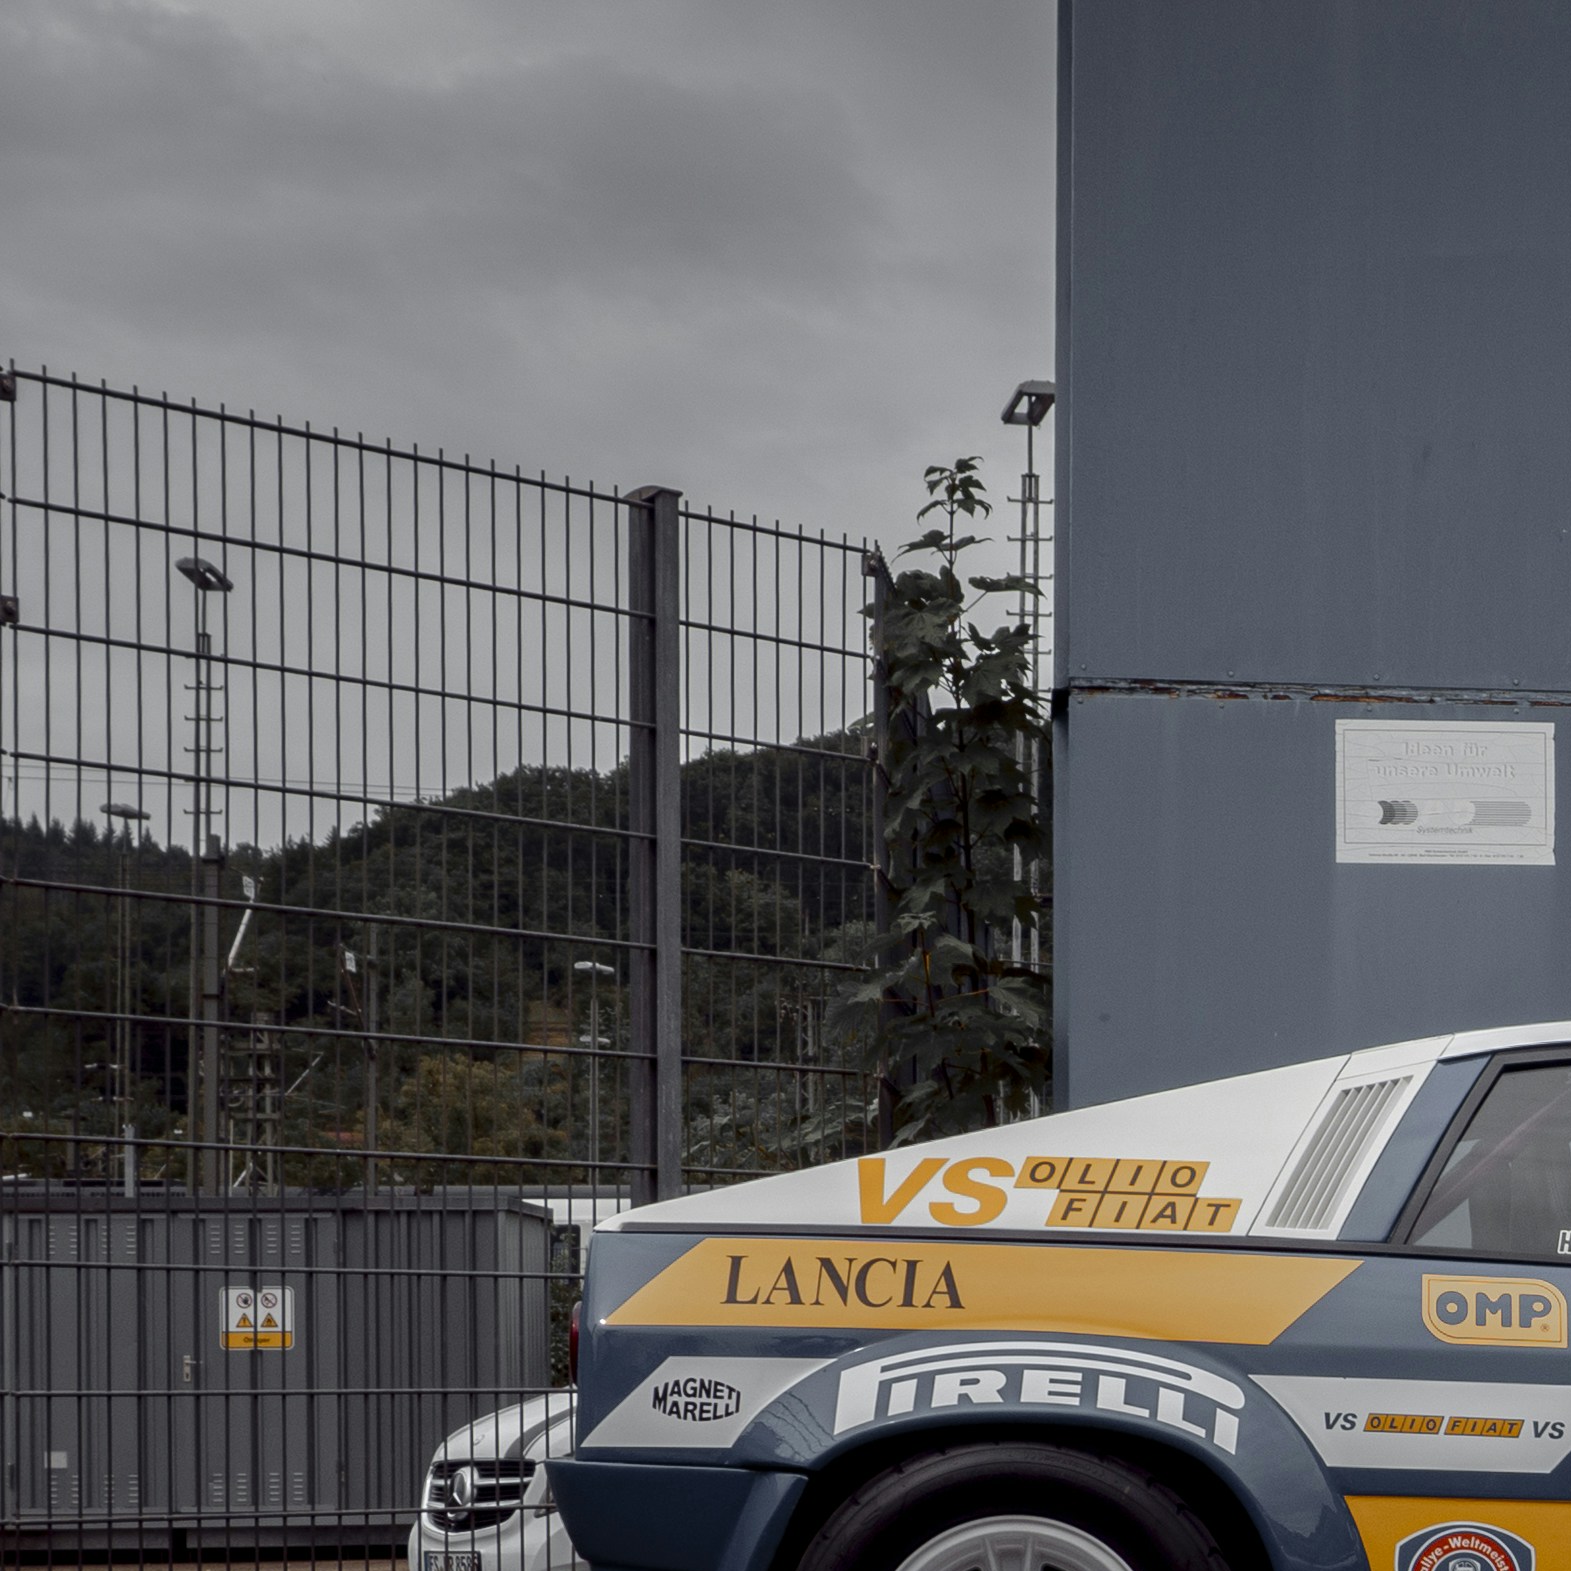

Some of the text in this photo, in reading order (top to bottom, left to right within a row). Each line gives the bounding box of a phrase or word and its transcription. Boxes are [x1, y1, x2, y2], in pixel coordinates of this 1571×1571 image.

[857, 1157, 1015, 1227] VS
[1029, 1161, 1196, 1189] OLIO
[1060, 1197, 1231, 1227] FIAT
[720, 1255, 966, 1310] LANCIA
[1436, 1291, 1552, 1328] OMP
[652, 1377, 741, 1414] MAGNETI
[652, 1383, 741, 1421] MARELLI
[834, 1341, 1246, 1455] PIRELLI
[1324, 1412, 1566, 1440] VS OLIO FIAT VS
